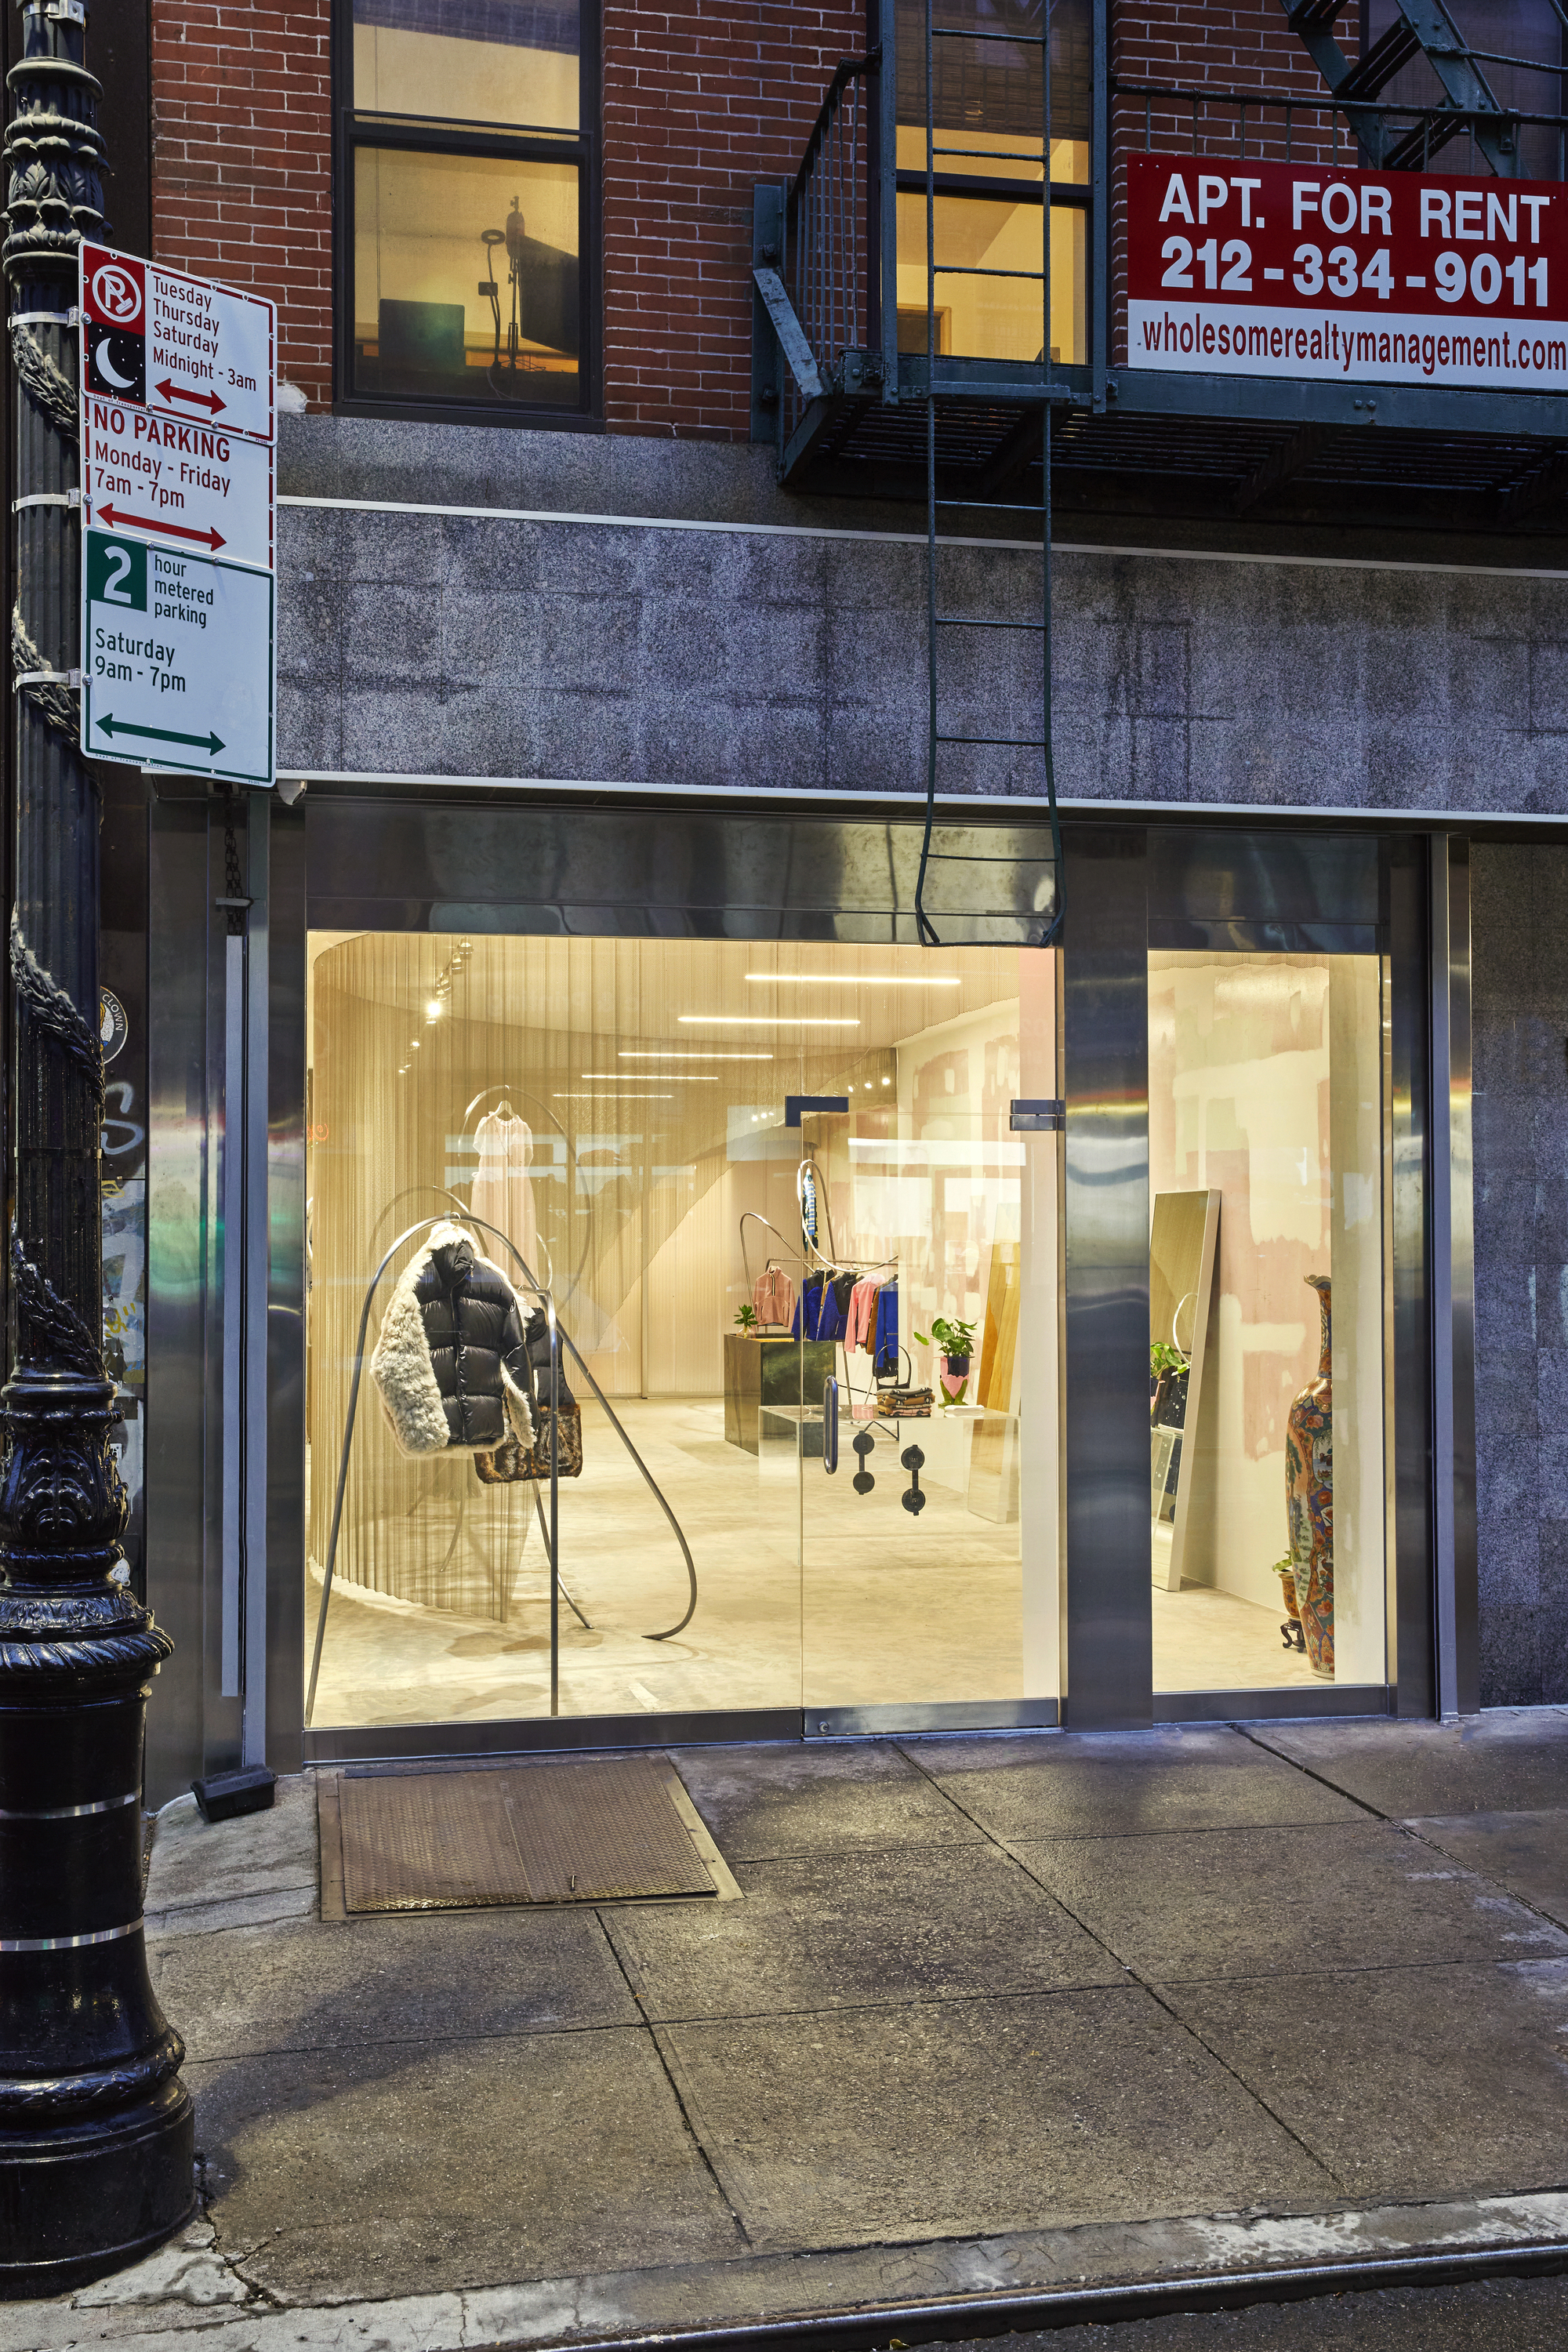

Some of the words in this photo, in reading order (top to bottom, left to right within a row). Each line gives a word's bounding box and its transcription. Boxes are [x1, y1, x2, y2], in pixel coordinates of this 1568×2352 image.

[1159, 173, 1265, 228] APT.
[1293, 181, 1392, 235] FOR
[1421, 188, 1550, 244] RENT
[153, 275, 212, 312] Tuesday
[153, 298, 220, 336] Thursday
[154, 320, 219, 358] Saturday
[1142, 311, 1566, 376] wholesomerealtymanagement.com
[153, 346, 214, 379] Midnight
[227, 368, 256, 391] 3am
[116, 401, 154, 414] Transportatin
[94, 403, 125, 435] NO
[134, 414, 230, 463] PARKING
[95, 440, 162, 480] Monday
[180, 462, 230, 497] Friday
[95, 467, 131, 495] 7am
[149, 481, 184, 508] 7pm
[103, 546, 132, 604] 2
[154, 554, 187, 577] hour
[154, 579, 214, 605] metered
[154, 601, 207, 629] parking
[95, 627, 175, 667] Saturday
[95, 655, 132, 681] 9am
[150, 666, 186, 692] 7pm
[102, 993, 124, 1032] CLOWN
